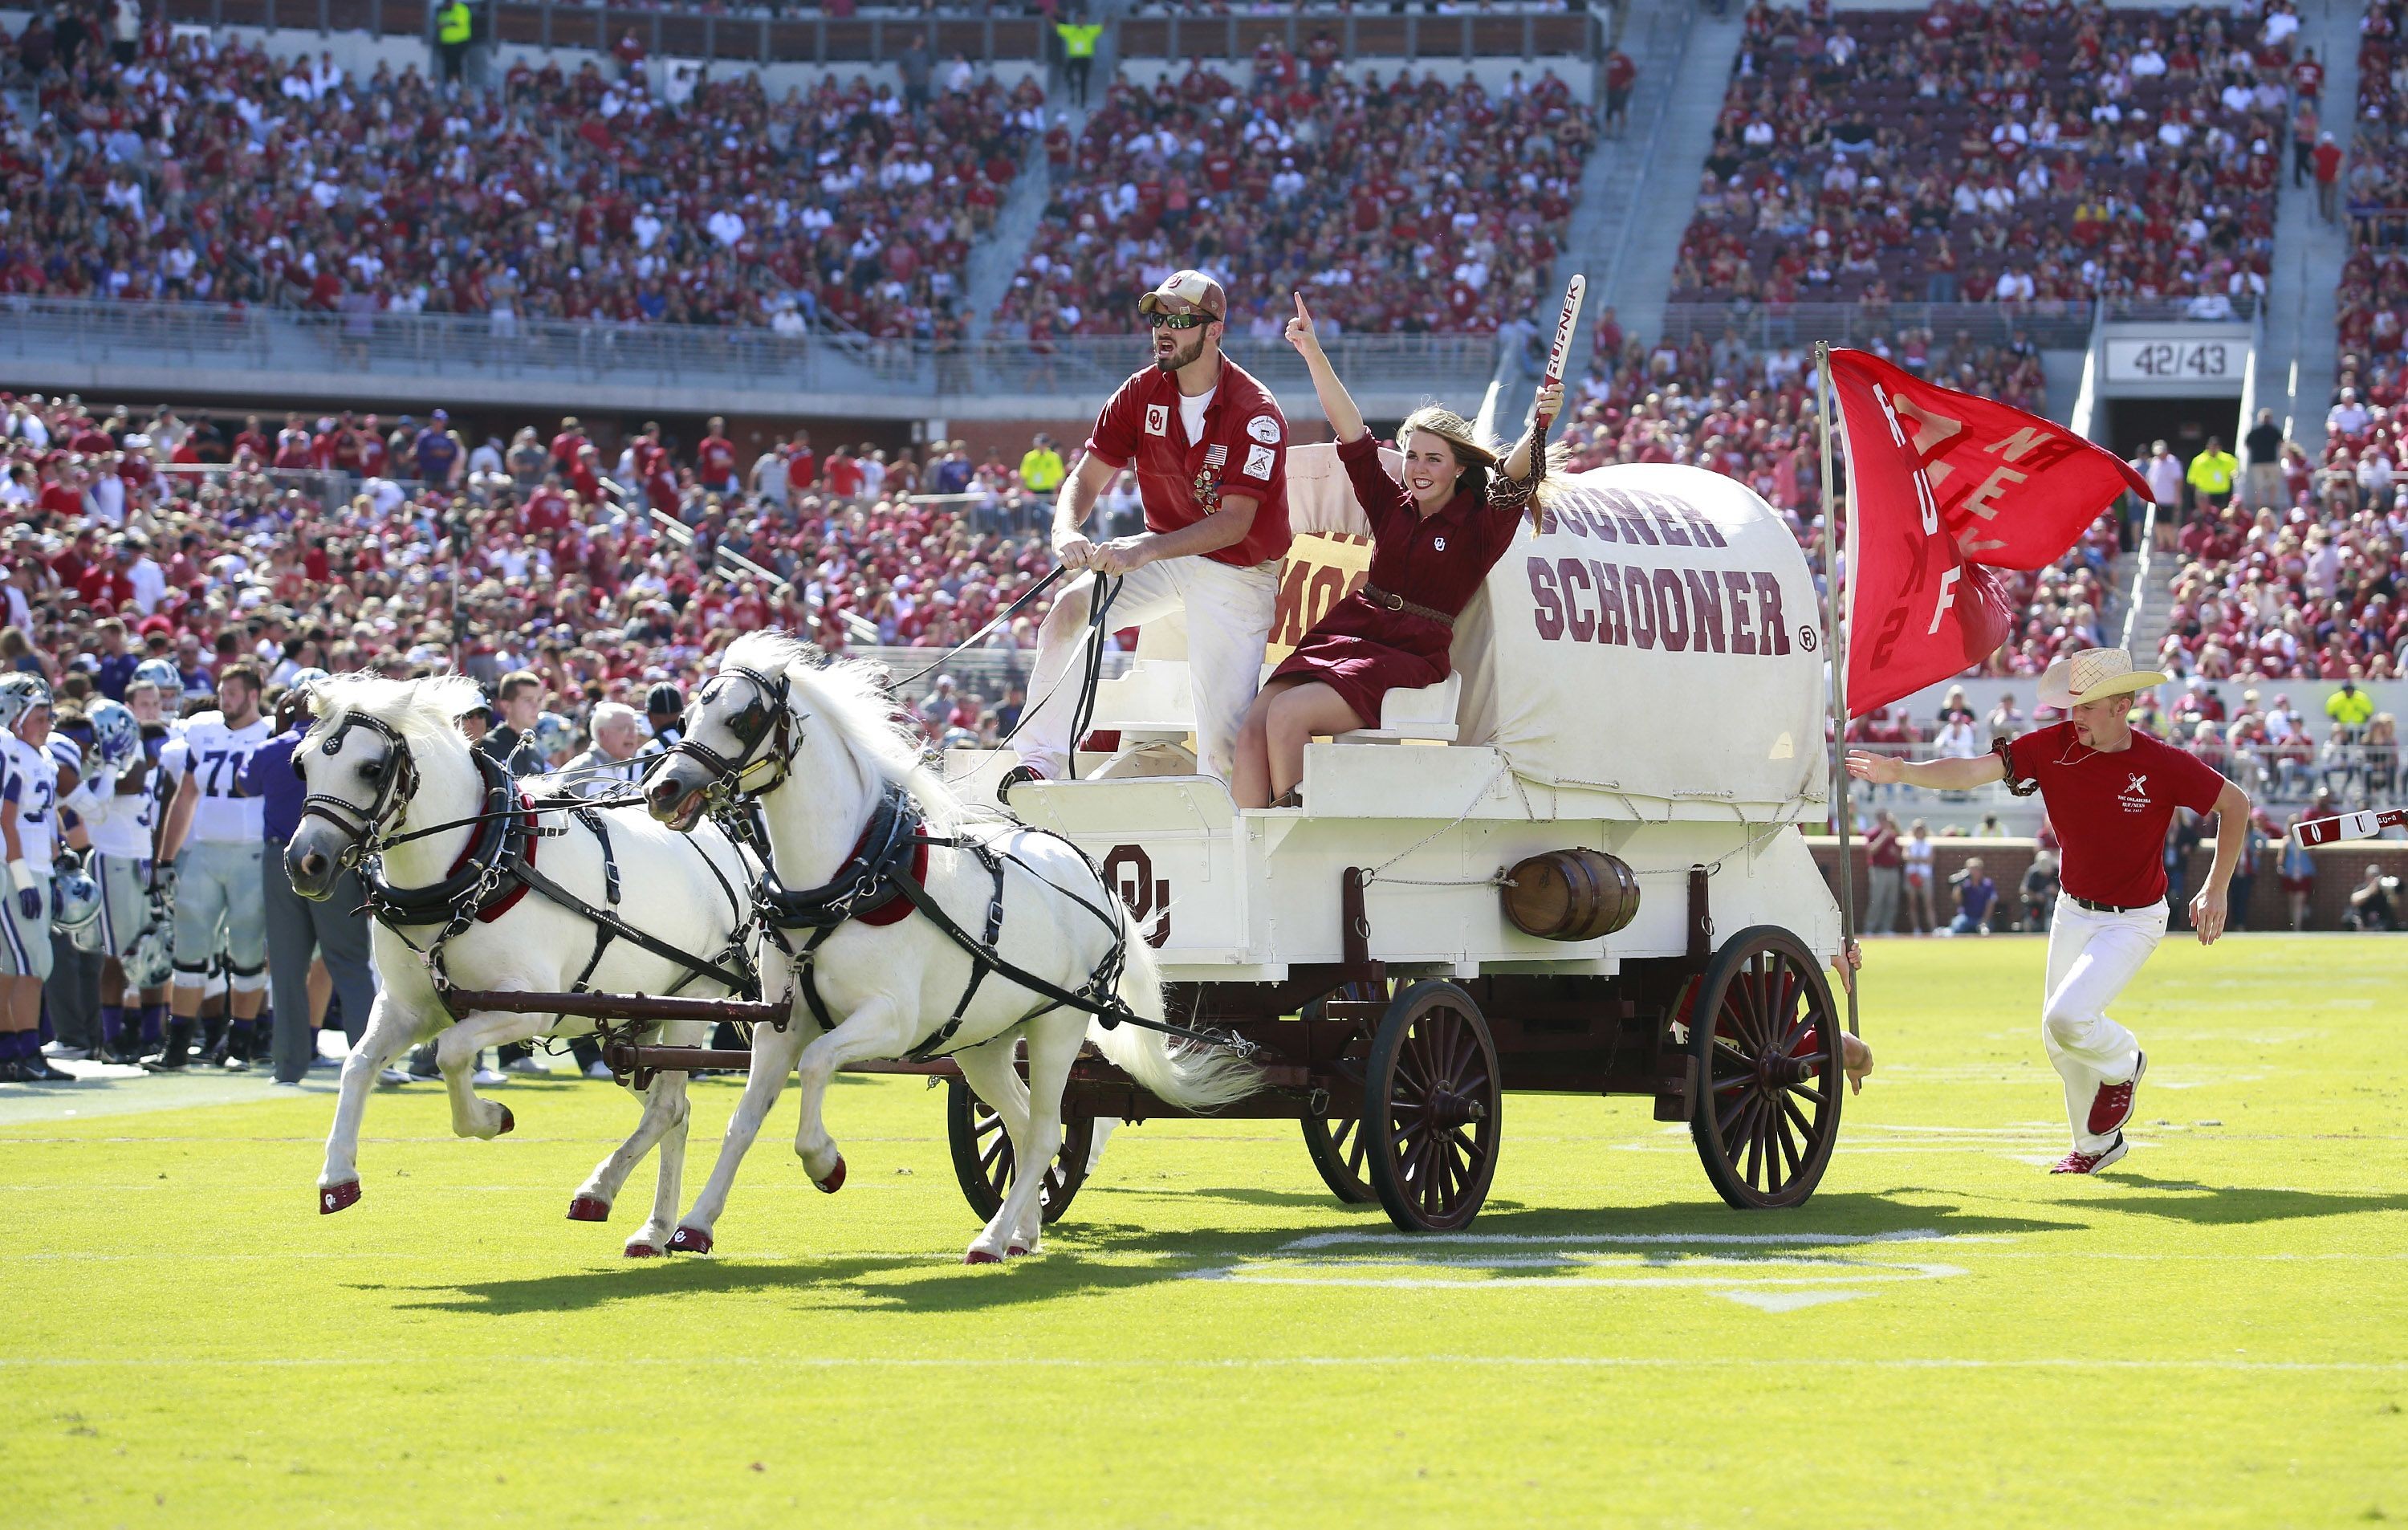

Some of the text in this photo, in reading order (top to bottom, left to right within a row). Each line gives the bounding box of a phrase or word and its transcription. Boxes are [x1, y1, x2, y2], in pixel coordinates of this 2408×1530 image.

[1547, 283, 1579, 377] RUFNEK
[2134, 344, 2227, 376] 42/43
[1149, 409, 1163, 431] OU
[1434, 537, 1446, 551] OU
[1527, 555, 1791, 656] SCHOONER
[203, 750, 246, 798] 71
[1103, 844, 1171, 949] OU
